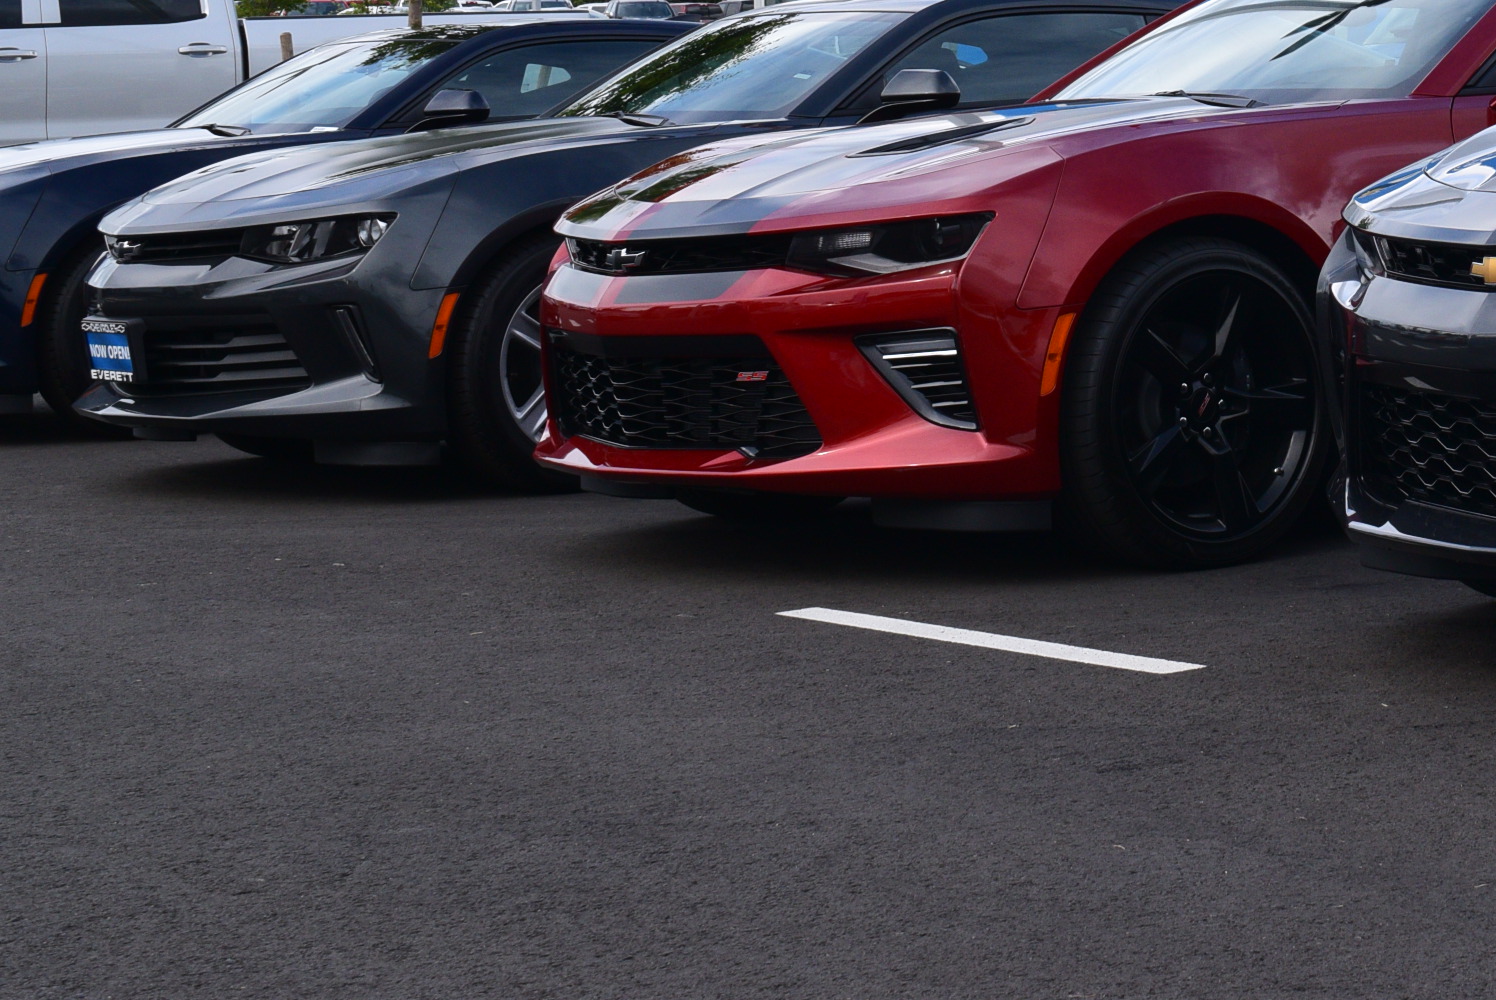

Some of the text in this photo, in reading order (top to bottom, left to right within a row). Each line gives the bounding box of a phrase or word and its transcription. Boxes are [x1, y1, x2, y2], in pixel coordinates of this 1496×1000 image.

[89, 344, 131, 360] NOW OPEN!
[90, 369, 133, 382] EVERETT
[736, 371, 769, 382] SS
